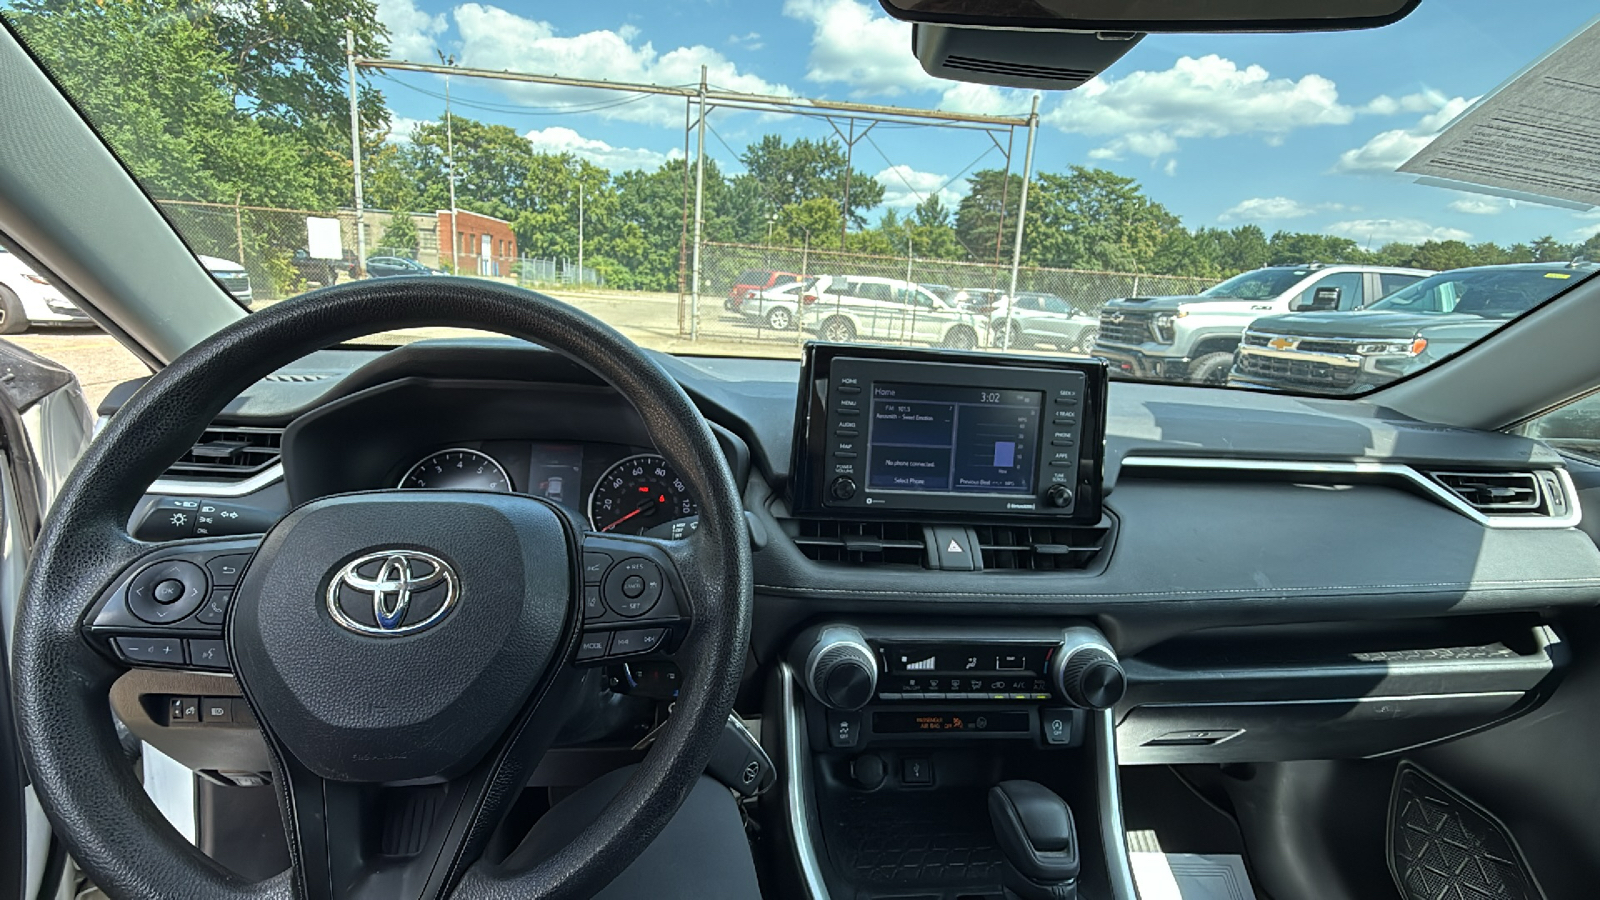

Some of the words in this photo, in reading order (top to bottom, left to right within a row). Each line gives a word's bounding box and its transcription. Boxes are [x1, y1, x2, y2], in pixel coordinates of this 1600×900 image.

[875, 388, 895, 396] Home
[981, 392, 1000, 403] 3:02
[435, 466, 443, 474] 3
[632, 467, 643, 476] 60
[655, 467, 666, 476] 80
[418, 479, 426, 487] 2
[613, 478, 623, 489] 40
[673, 478, 685, 492] 100
[603, 498, 612, 510] 20
[682, 499, 691, 514] 120
